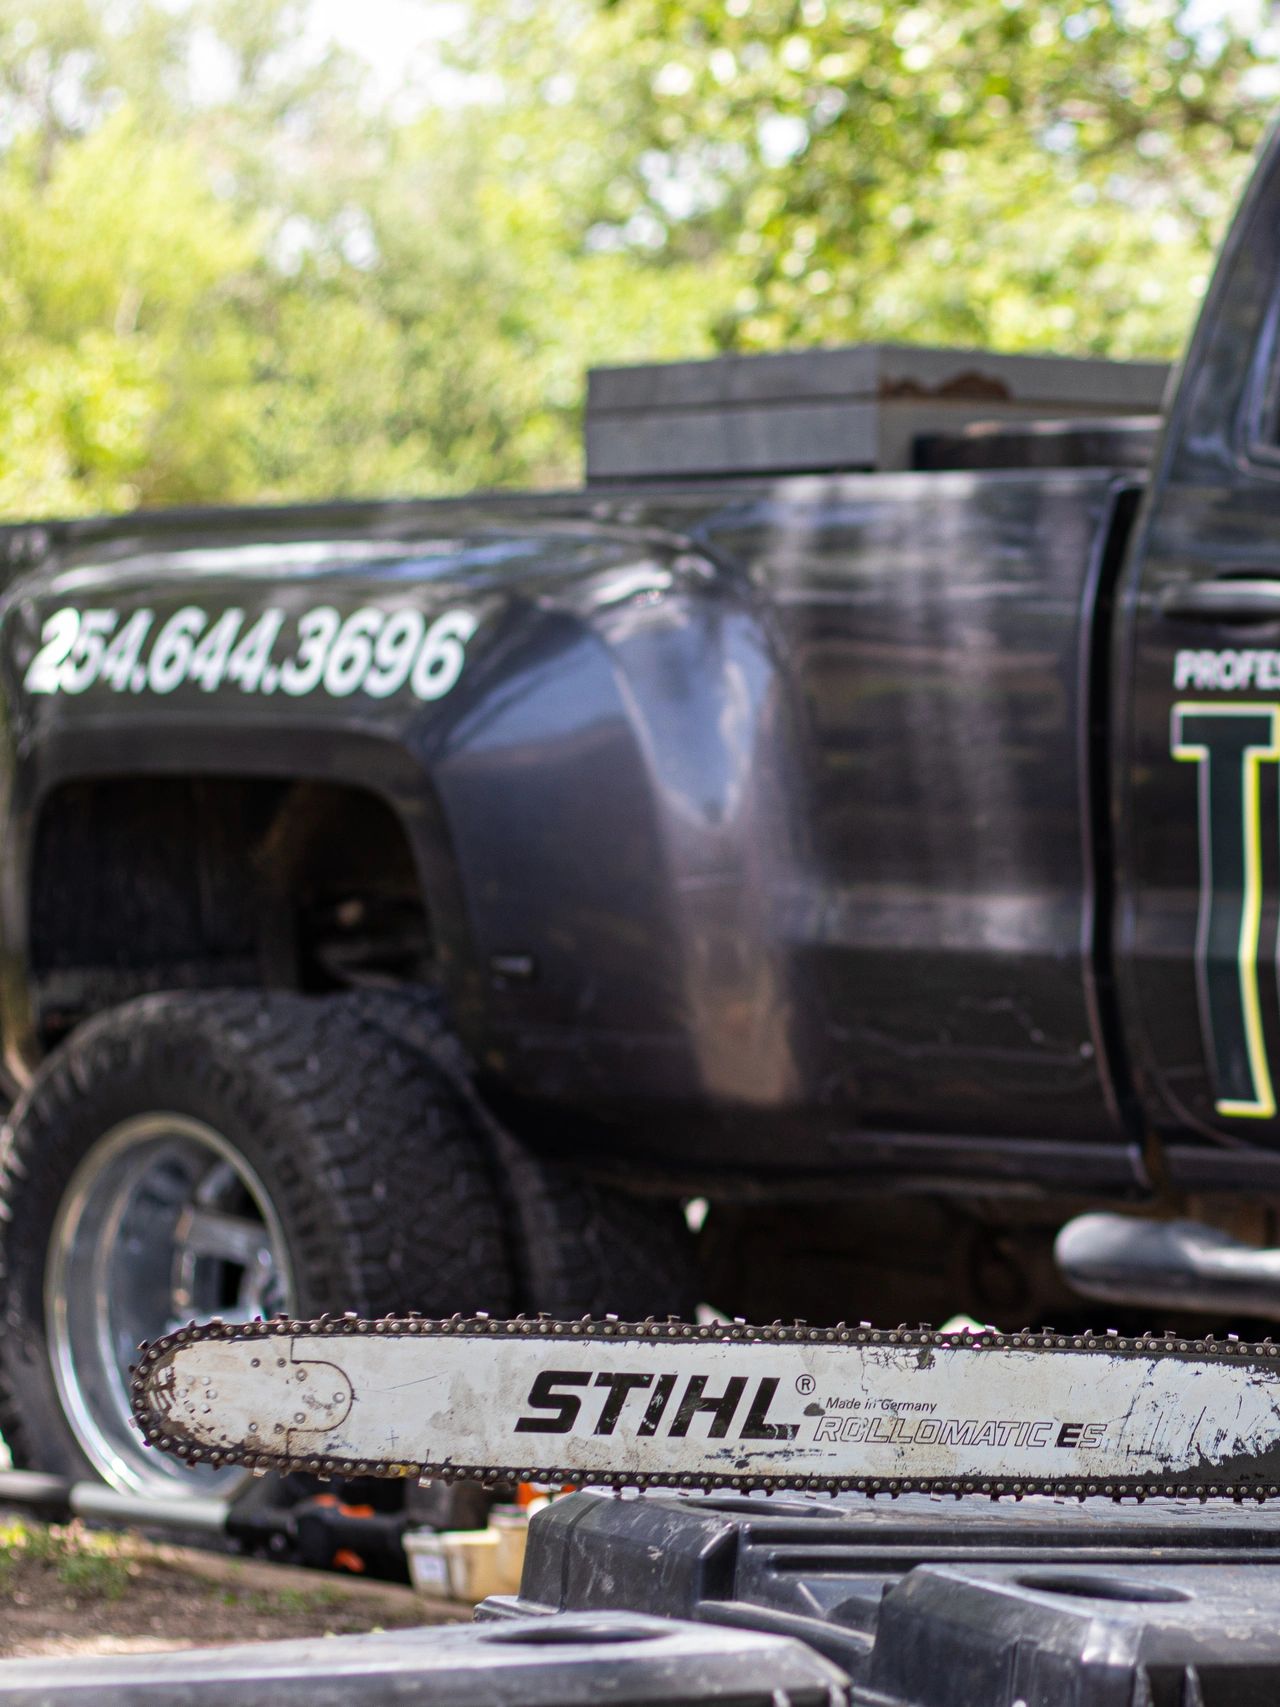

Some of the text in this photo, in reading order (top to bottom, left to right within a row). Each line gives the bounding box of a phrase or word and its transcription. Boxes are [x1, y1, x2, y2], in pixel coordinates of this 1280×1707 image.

[23, 606, 480, 700] 254.644.3696
[513, 1370, 801, 1441] STIHL
[825, 1397, 938, 1414] Made in Germany
[813, 1416, 1108, 1449] ROLLOMATIC ES
